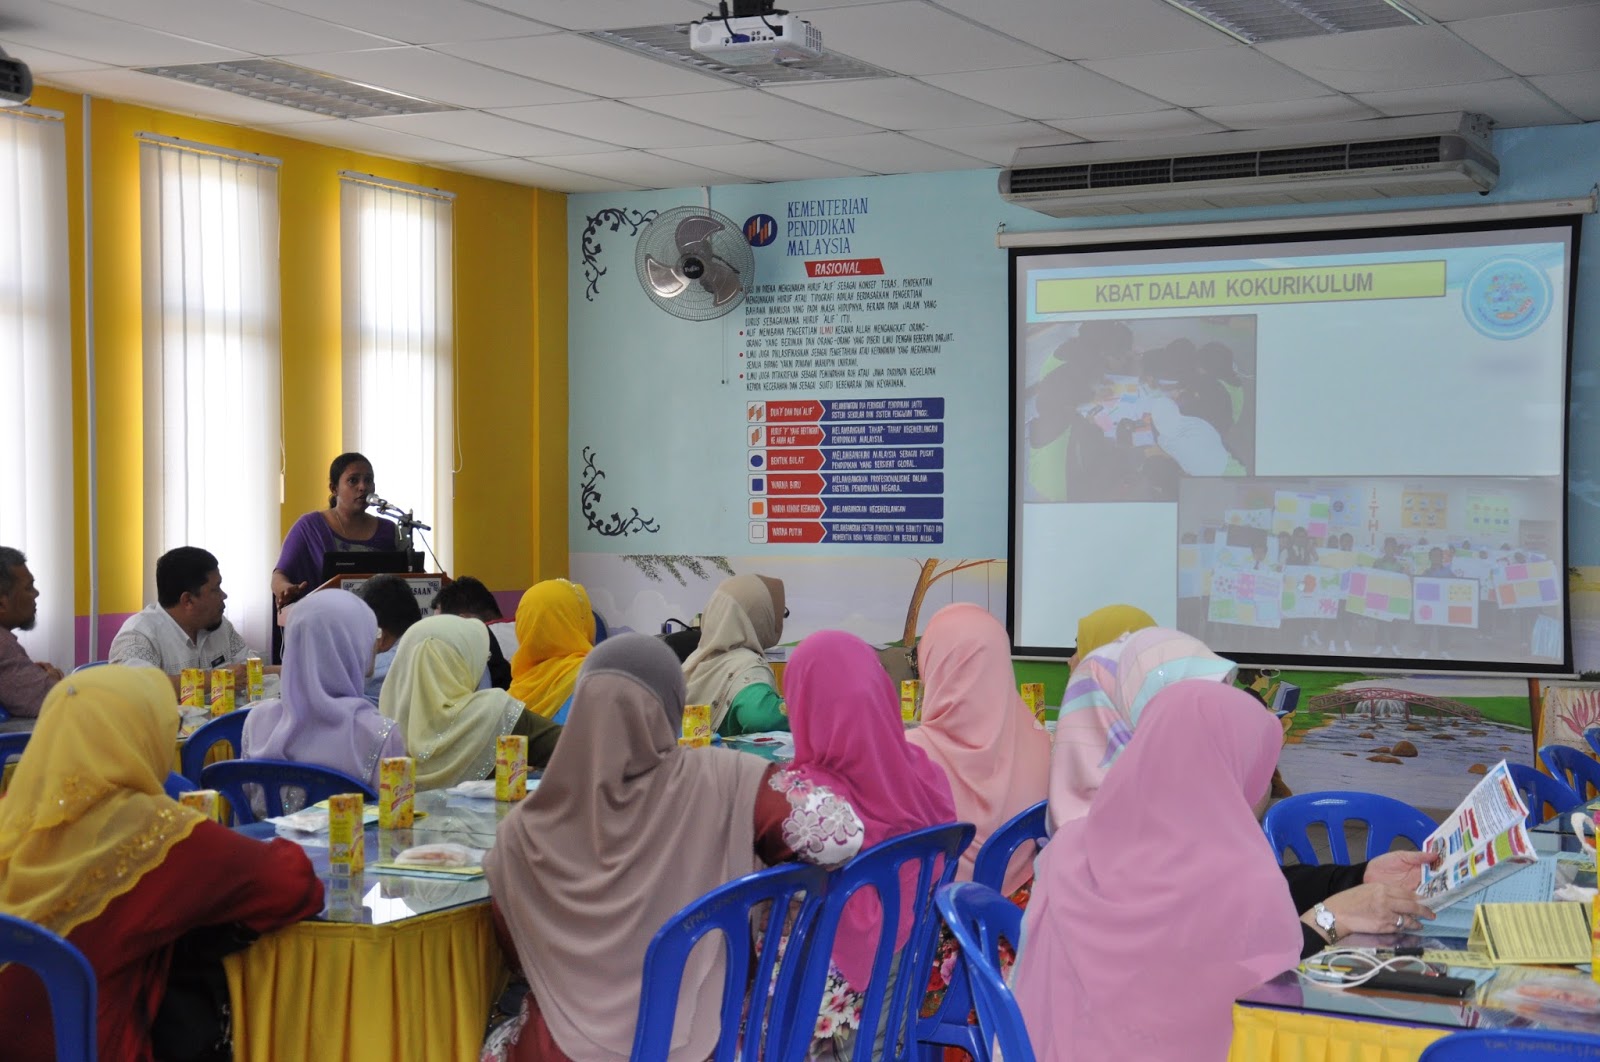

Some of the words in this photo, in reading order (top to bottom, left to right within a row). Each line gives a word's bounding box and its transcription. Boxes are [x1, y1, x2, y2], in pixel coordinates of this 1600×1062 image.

[787, 198, 868, 218] KEMENTERIAN
[787, 218, 855, 237] PENDIDIKAN
[786, 238, 850, 256] MALAYSIA
[814, 260, 861, 275] RASIONAL
[892, 289, 922, 299] PENGERTIAN
[1096, 283, 1143, 302] KBAT
[1149, 280, 1215, 300] DALAM
[1226, 272, 1373, 298] KOKURIKULUM
[902, 301, 920, 310] JALAN
[786, 326, 818, 336] PENGERTIAN
[820, 326, 834, 335] ILMU
[835, 325, 854, 334] KERANA
[856, 324, 871, 334] ALLAH
